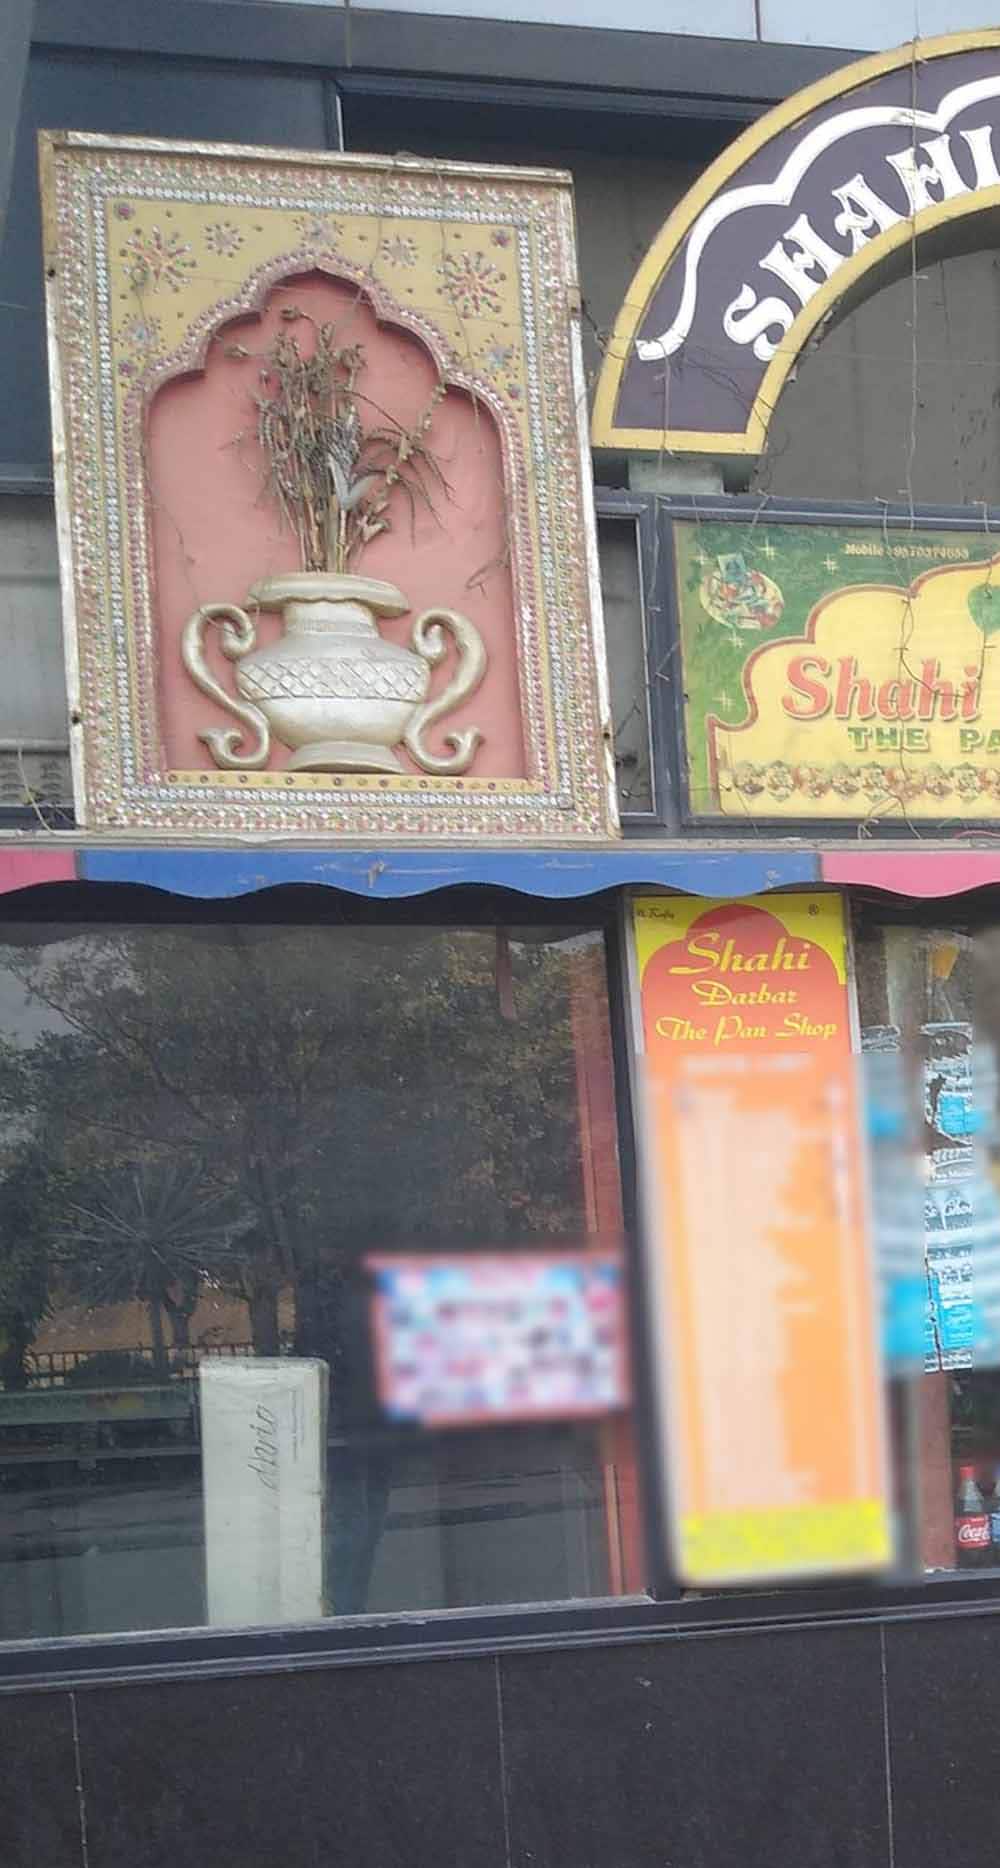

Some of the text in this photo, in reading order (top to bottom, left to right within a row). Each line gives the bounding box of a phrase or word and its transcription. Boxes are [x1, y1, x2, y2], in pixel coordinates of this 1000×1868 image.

[782, 655, 984, 722] Shahi
[846, 726, 930, 753] THE
[669, 932, 811, 976] Shahi
[691, 979, 798, 1007] Darbar
[655, 1012, 838, 1047] The Pan Shop
